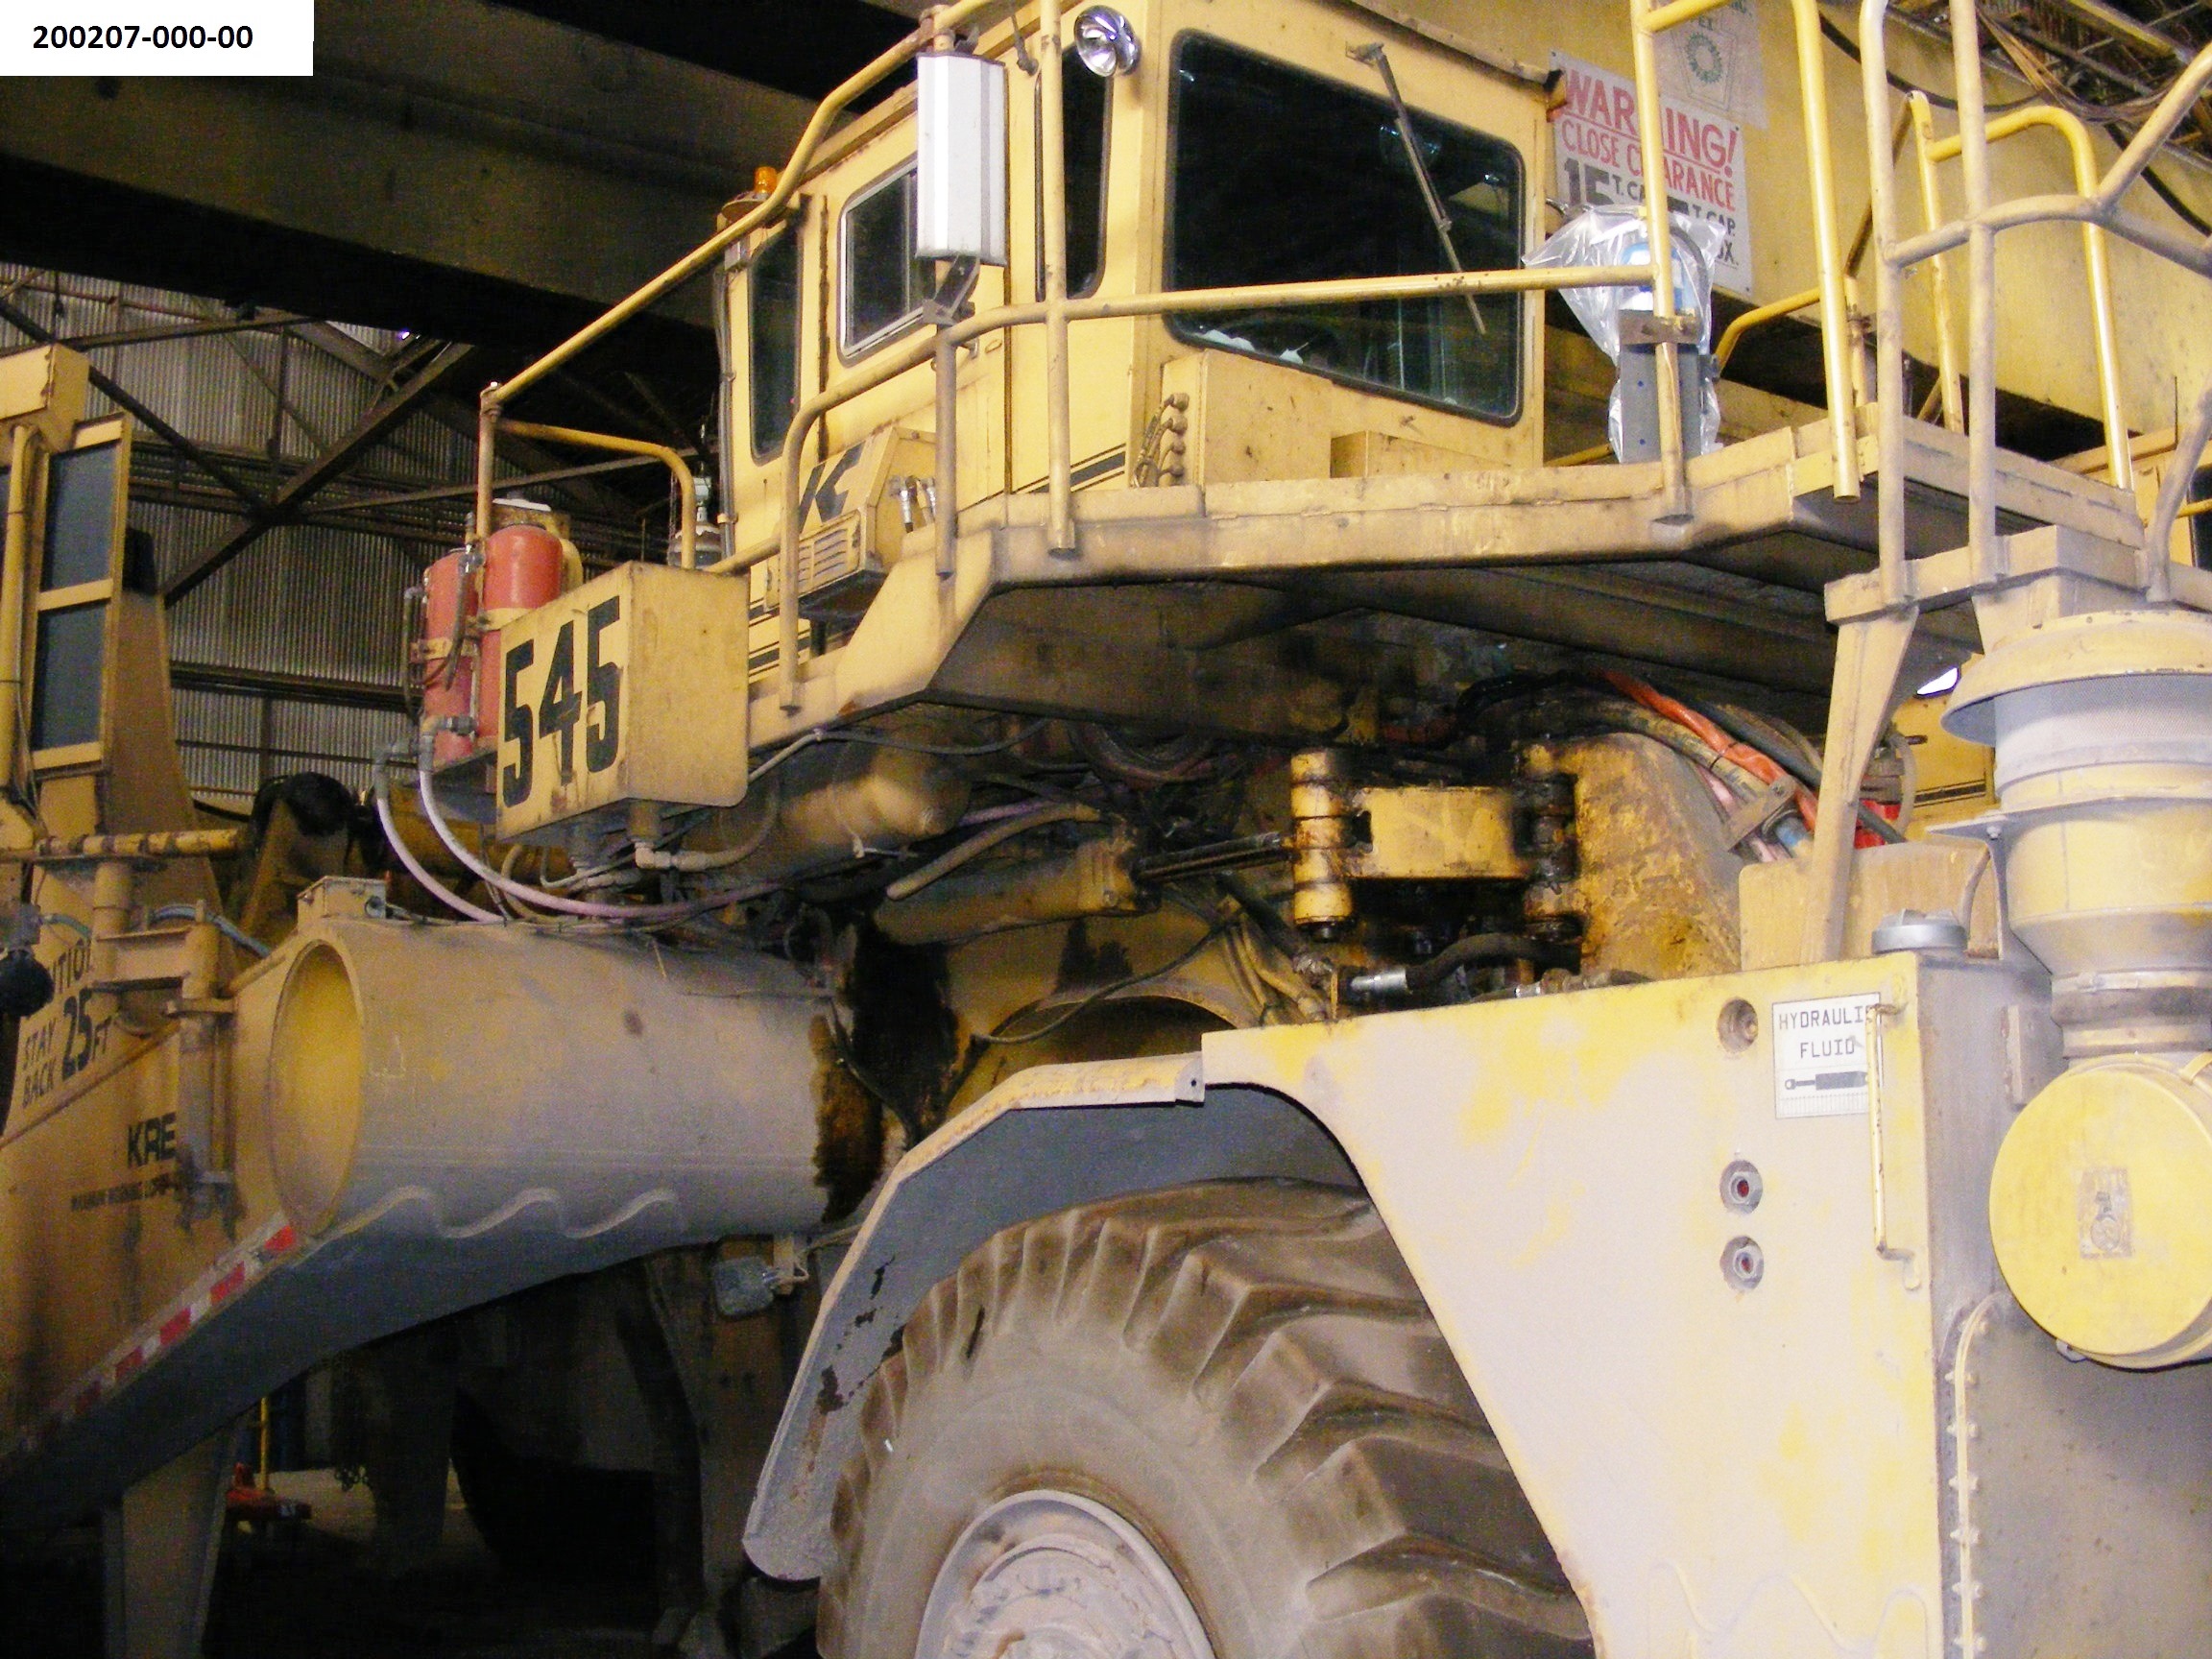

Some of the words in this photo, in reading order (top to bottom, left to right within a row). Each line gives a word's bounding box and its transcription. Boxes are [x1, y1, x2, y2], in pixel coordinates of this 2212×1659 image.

[1560, 119, 1621, 169] CLOSE
[1626, 143, 1737, 212] CARANCE
[1565, 68, 1738, 179] WARING!
[502, 594, 621, 808] 545
[1779, 1003, 1876, 1030] HYDRAULI
[1799, 1036, 1856, 1059] FLUID
